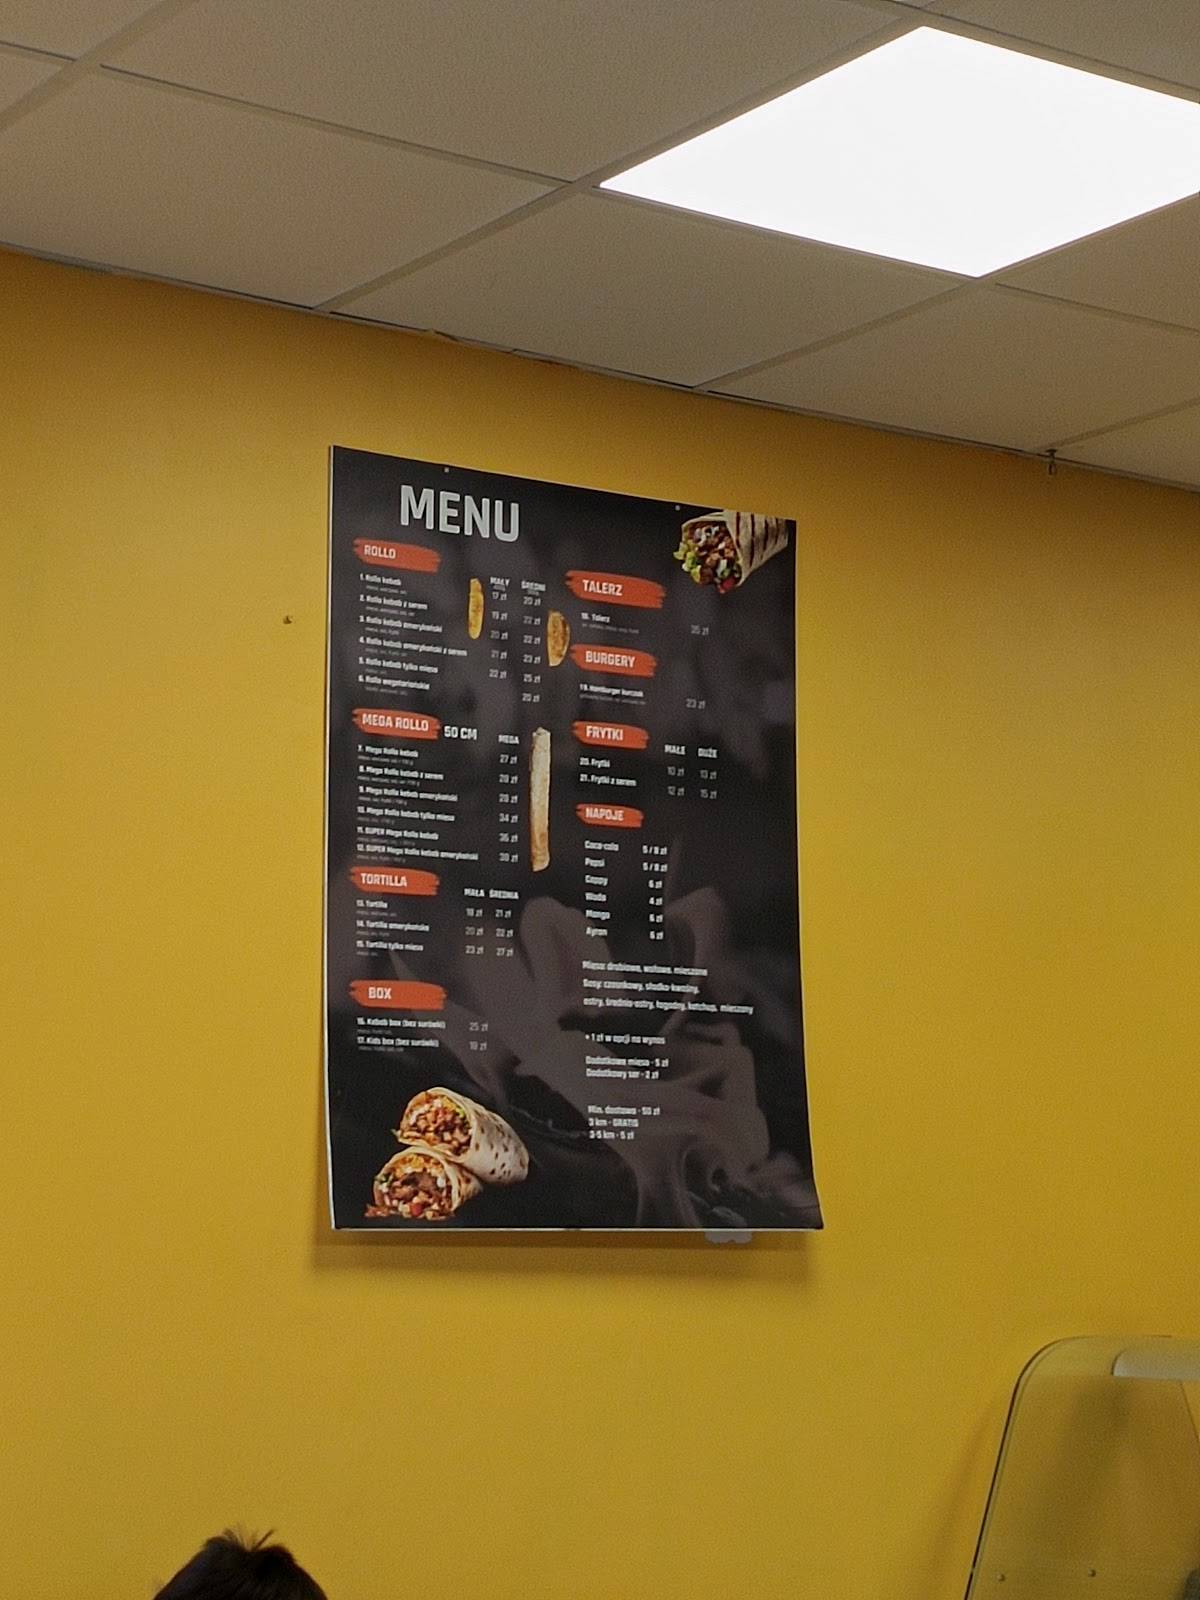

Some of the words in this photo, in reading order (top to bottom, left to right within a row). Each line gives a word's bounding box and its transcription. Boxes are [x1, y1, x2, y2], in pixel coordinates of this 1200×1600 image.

[401, 484, 519, 542] MENU
[364, 545, 396, 559] ROLLO
[582, 580, 623, 596] TALERZ
[585, 651, 635, 668] BURGERY
[362, 713, 393, 728] MEGA
[395, 717, 429, 732] ROLLO
[444, 726, 458, 739] 50
[460, 728, 477, 741] CM
[585, 725, 624, 741] FRYTKI
[585, 807, 624, 821] NAPOJE
[361, 873, 408, 887] TORTILLA
[368, 987, 392, 999] BOX
